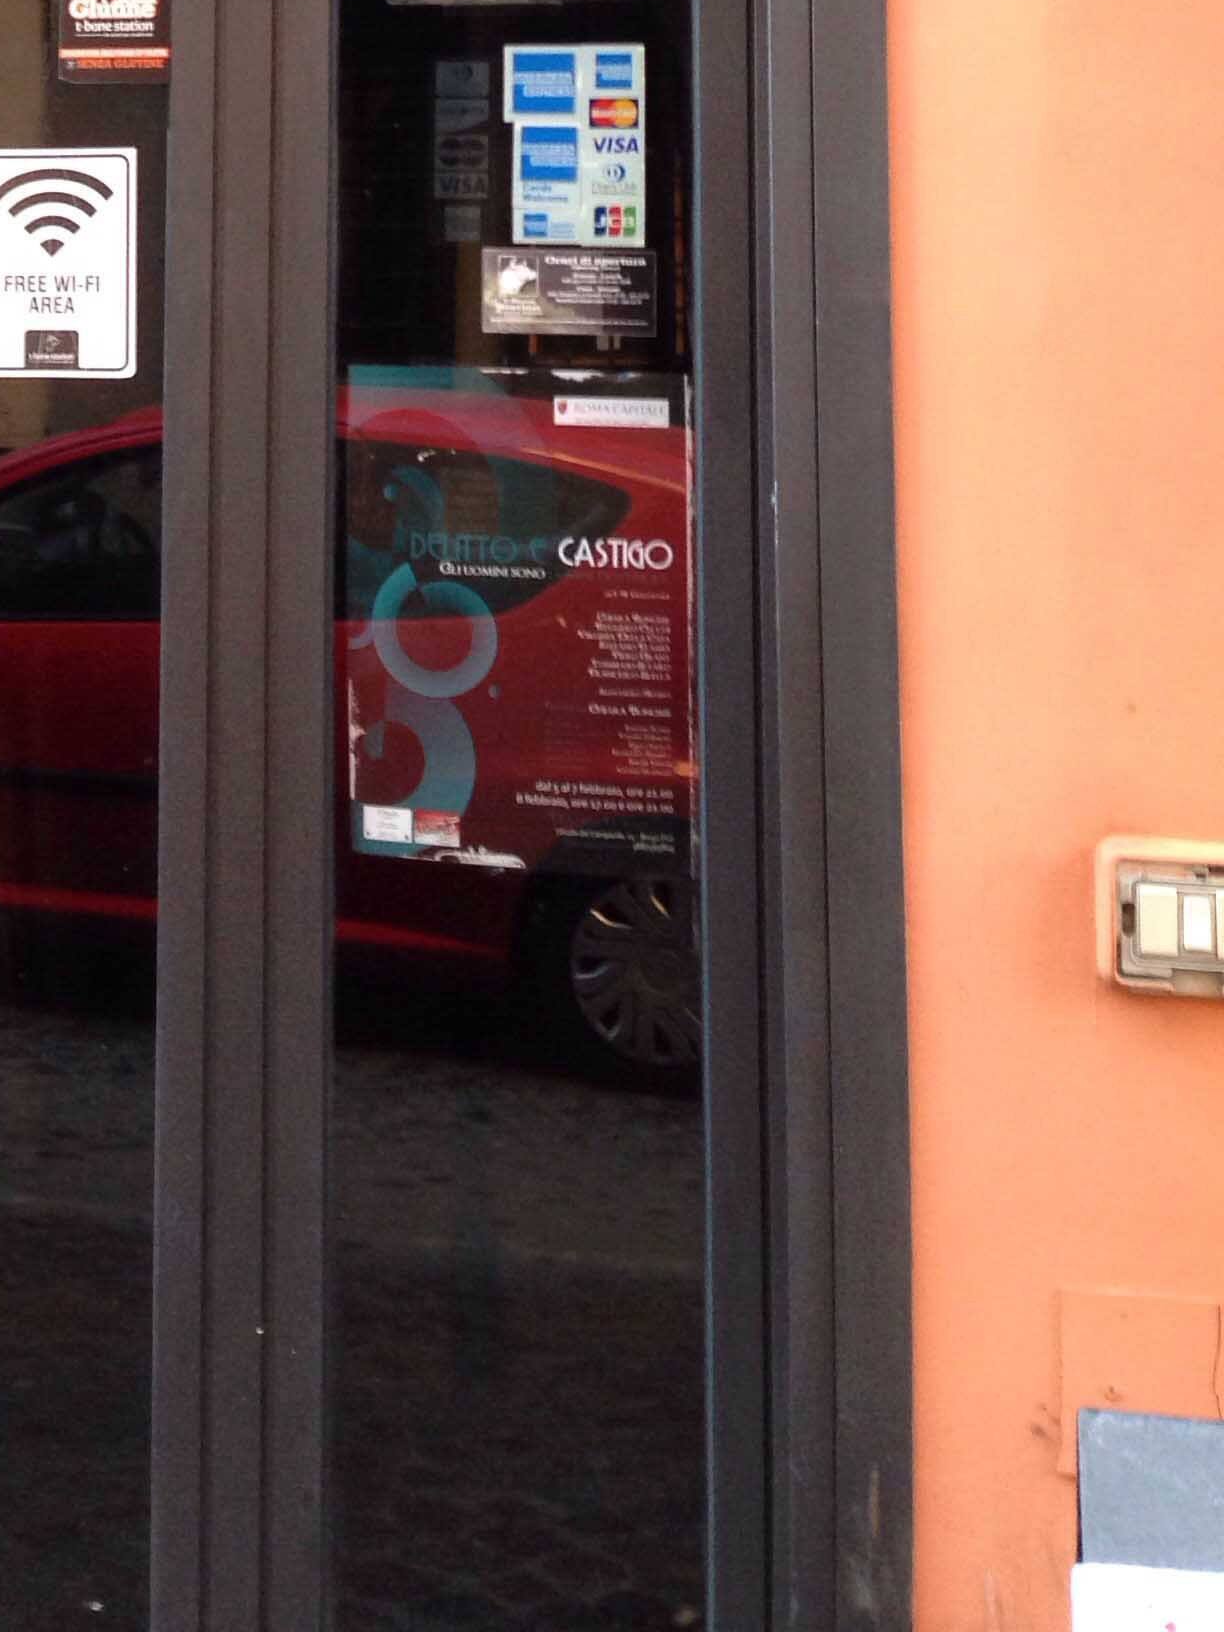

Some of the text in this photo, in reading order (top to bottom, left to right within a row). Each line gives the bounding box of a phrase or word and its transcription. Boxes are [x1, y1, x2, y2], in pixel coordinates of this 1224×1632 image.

[593, 136, 639, 154] VISA
[4, 275, 100, 292] FREE WI-FI
[29, 296, 75, 314] AREA
[558, 536, 673, 569] CASTIGO
